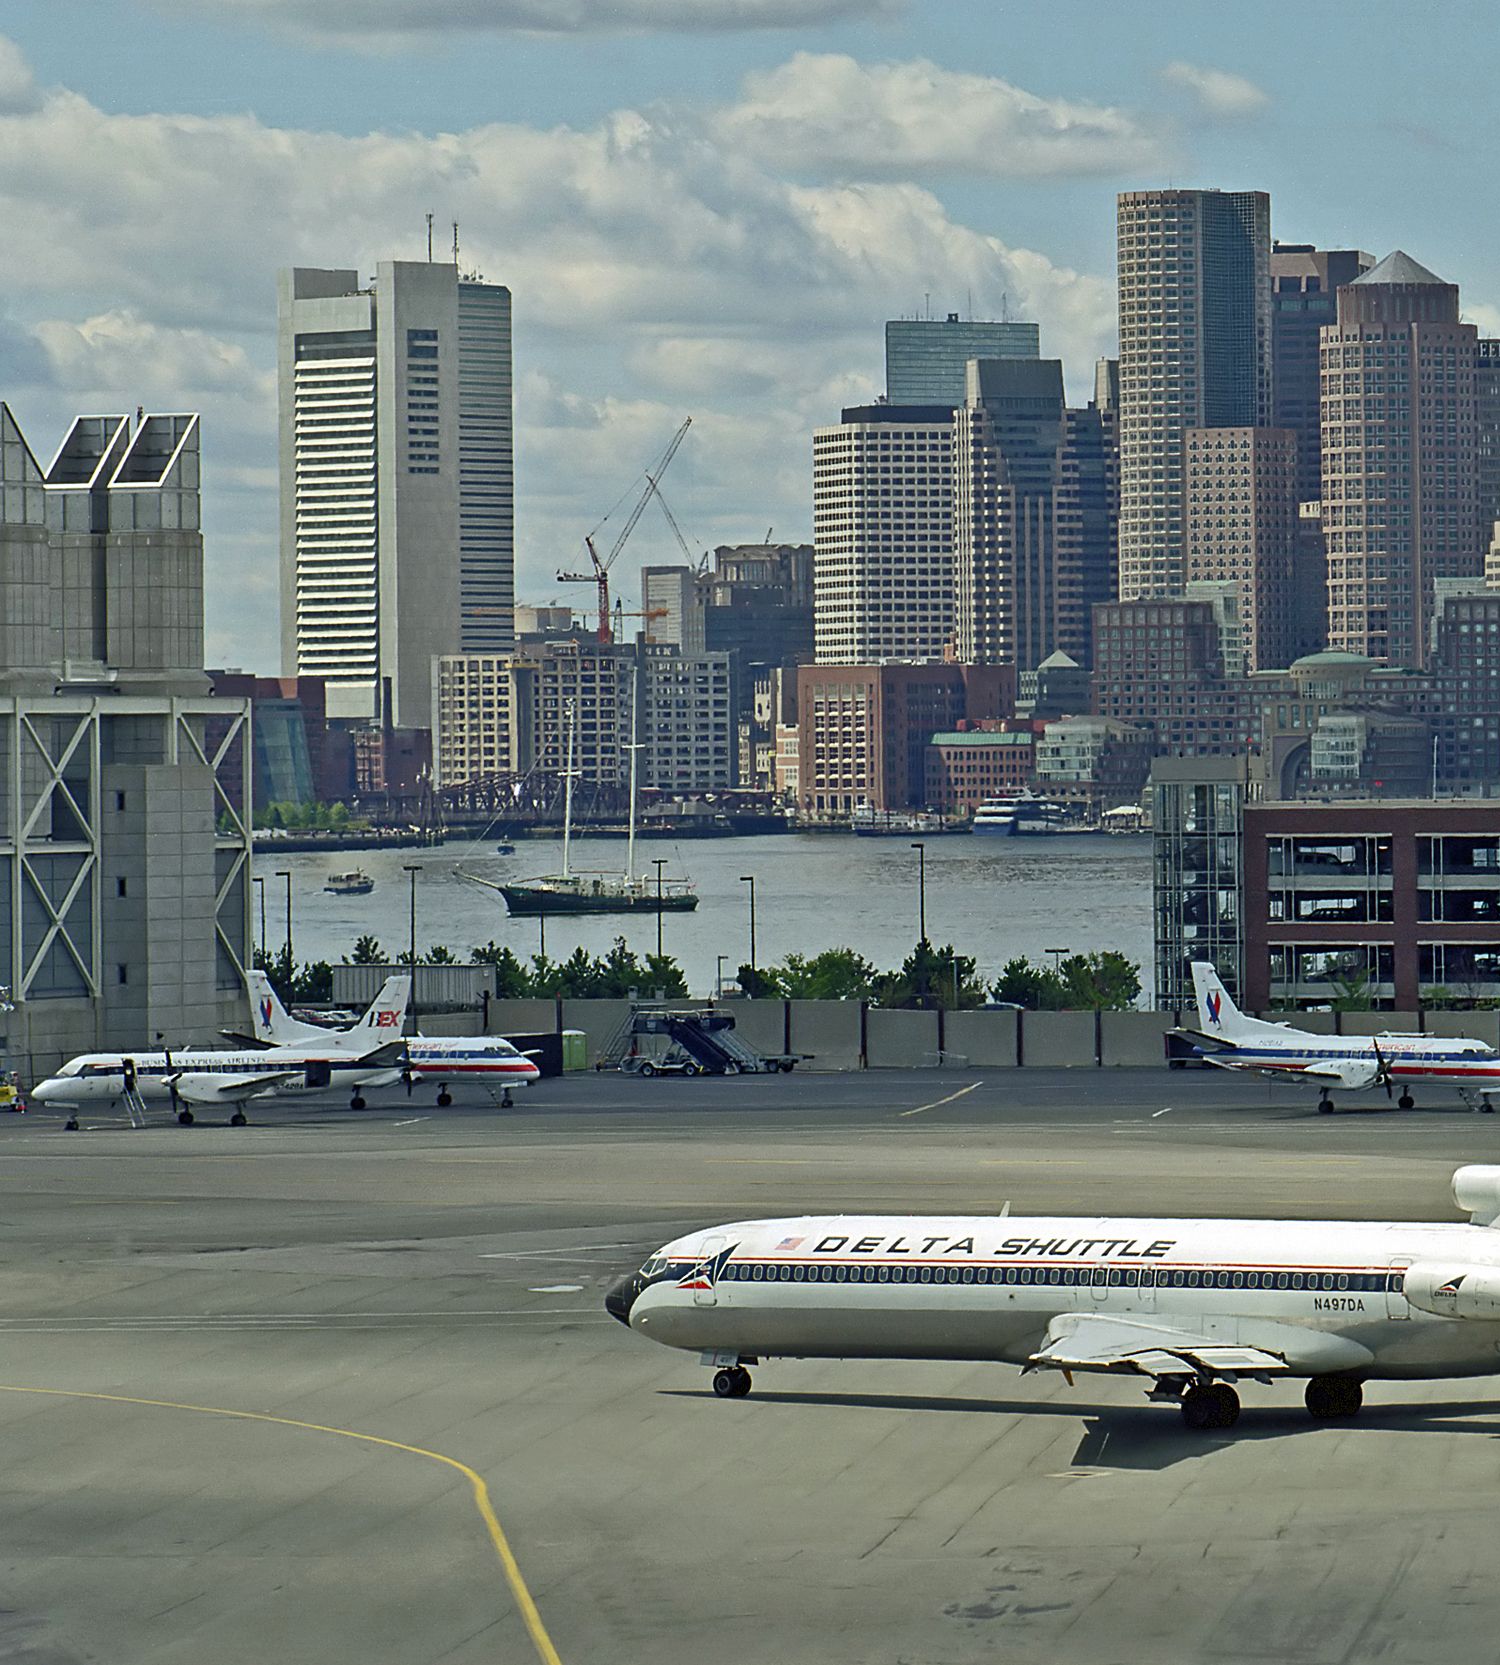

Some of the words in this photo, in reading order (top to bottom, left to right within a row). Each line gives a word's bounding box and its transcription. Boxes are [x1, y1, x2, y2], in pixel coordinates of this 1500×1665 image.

[368, 1010, 401, 1027] BEX
[141, 1058, 182, 1066] BUSINSS
[812, 1236, 975, 1255] DELTA
[994, 1238, 1177, 1259] SHUTTLE
[1314, 1297, 1365, 1311] N497DA
